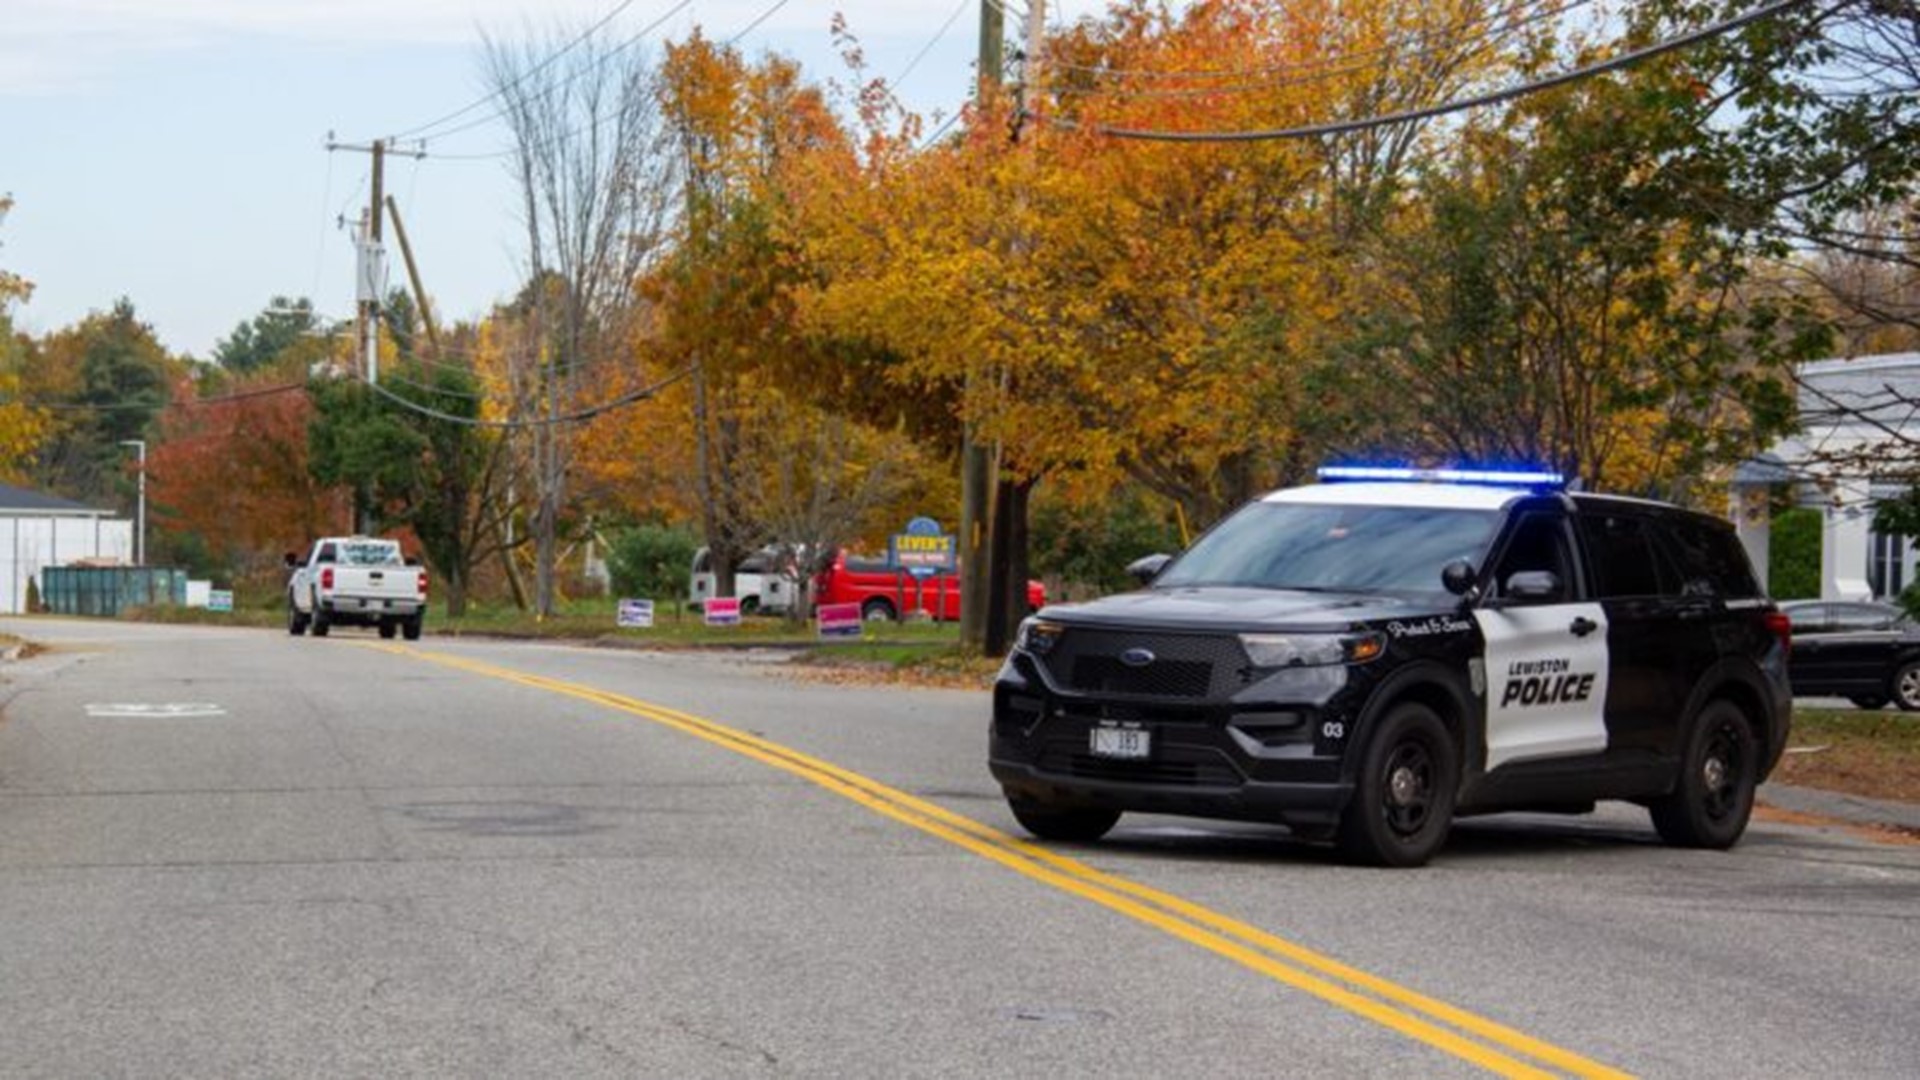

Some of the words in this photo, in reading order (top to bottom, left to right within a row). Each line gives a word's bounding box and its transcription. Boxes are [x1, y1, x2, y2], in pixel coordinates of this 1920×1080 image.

[1508, 659, 1569, 675] LEWISTON
[1501, 673, 1595, 707] POLICE
[1323, 721, 1343, 738] 03
